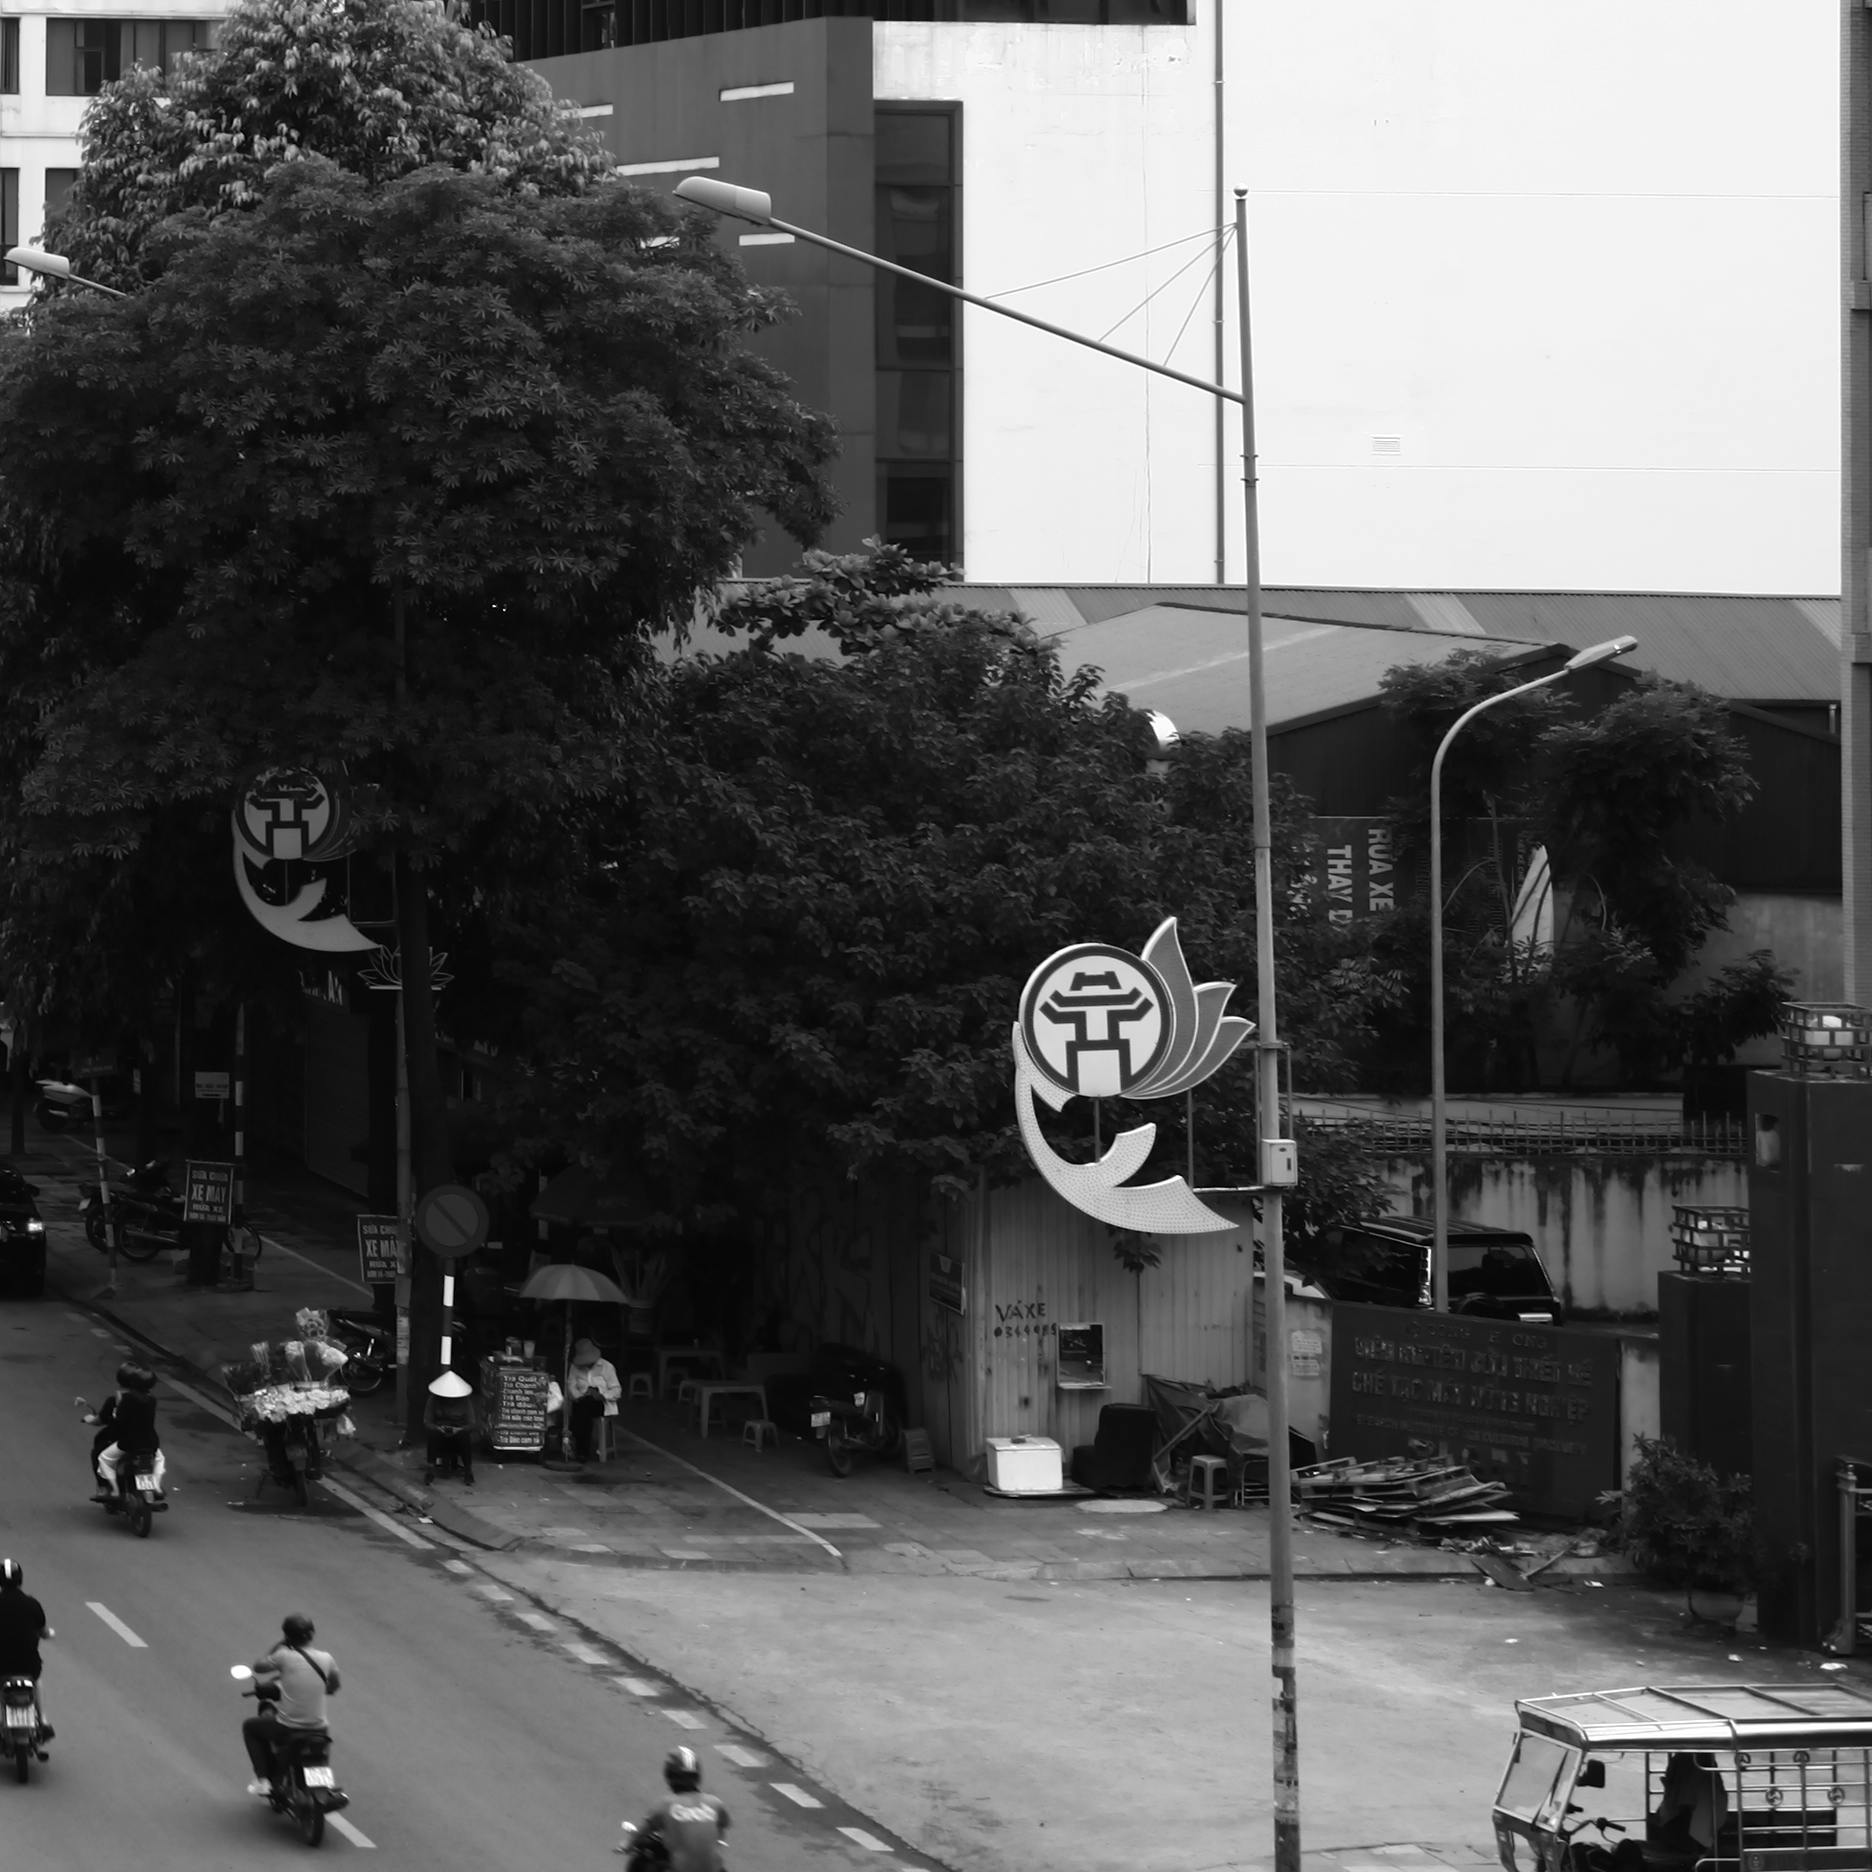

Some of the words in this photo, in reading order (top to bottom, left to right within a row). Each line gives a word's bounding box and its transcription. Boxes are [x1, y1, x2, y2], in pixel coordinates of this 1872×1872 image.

[1327, 844, 1353, 903] THAY
[1368, 880, 1395, 912] XE
[191, 1183, 205, 1202] XE
[365, 1239, 378, 1258] XE
